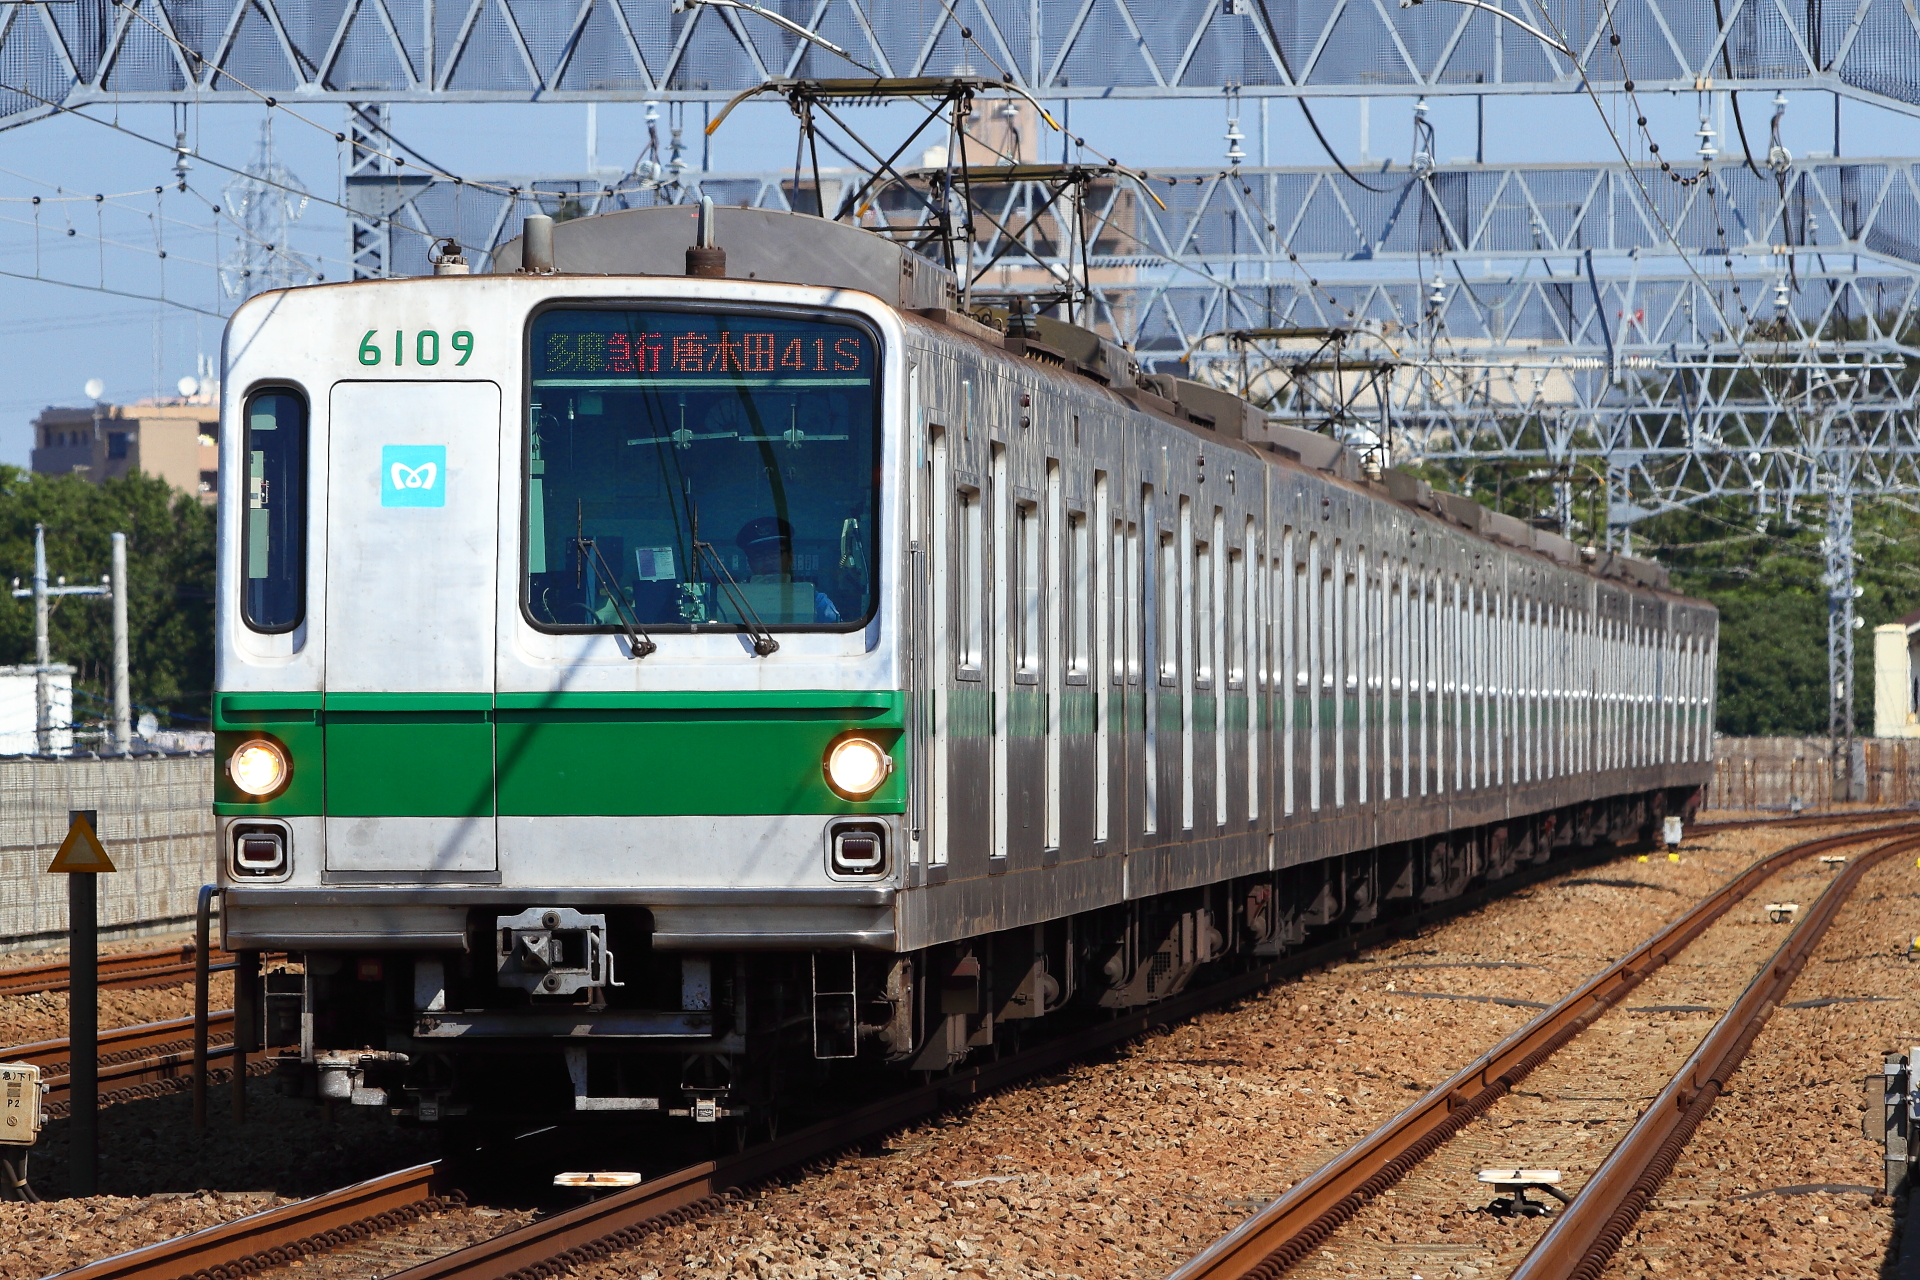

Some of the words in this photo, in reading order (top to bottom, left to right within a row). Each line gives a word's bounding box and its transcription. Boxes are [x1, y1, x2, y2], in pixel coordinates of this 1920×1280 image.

[358, 329, 475, 367] 6109
[671, 331, 775, 372] 唐木田
